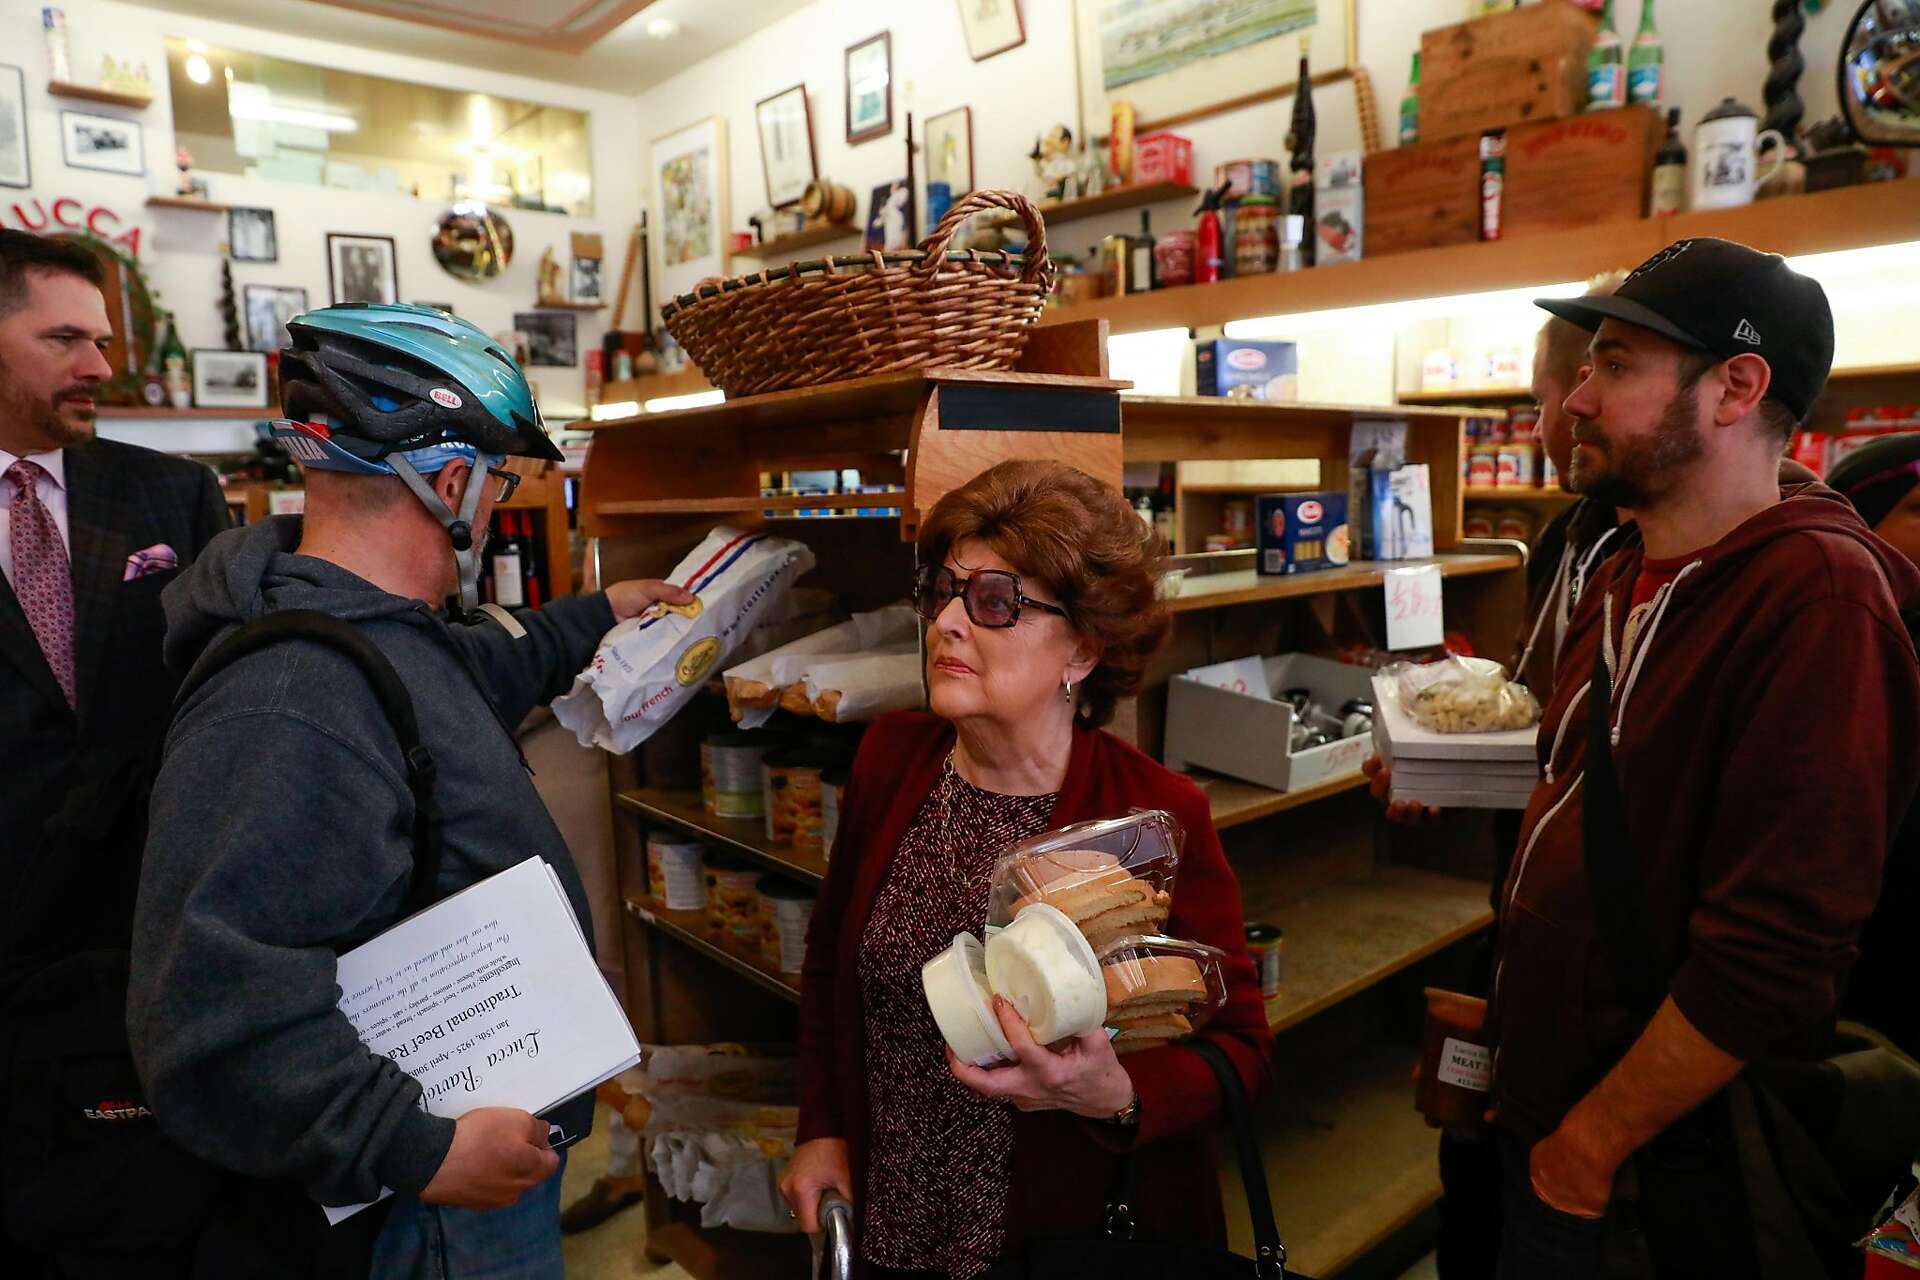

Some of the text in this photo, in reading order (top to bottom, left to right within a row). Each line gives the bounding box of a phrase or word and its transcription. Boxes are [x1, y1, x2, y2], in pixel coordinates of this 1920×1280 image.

[0, 197, 140, 257] UCCA
[432, 391, 459, 407] BELL
[475, 956, 521, 988] Ingredients:
[407, 993, 429, 1010] parsley
[441, 991, 457, 1004] beef
[415, 1000, 440, 1017] spinach
[385, 982, 524, 1065] Traditional Beef Ra
[394, 1014, 414, 1029] bread
[494, 1017, 512, 1032] Jan
[473, 1025, 496, 1045] 15th,
[454, 1037, 476, 1056] 1925
[427, 1049, 450, 1070] April
[417, 1026, 544, 1116] Lucca Raviol
[83, 1106, 152, 1120] EASTPA
